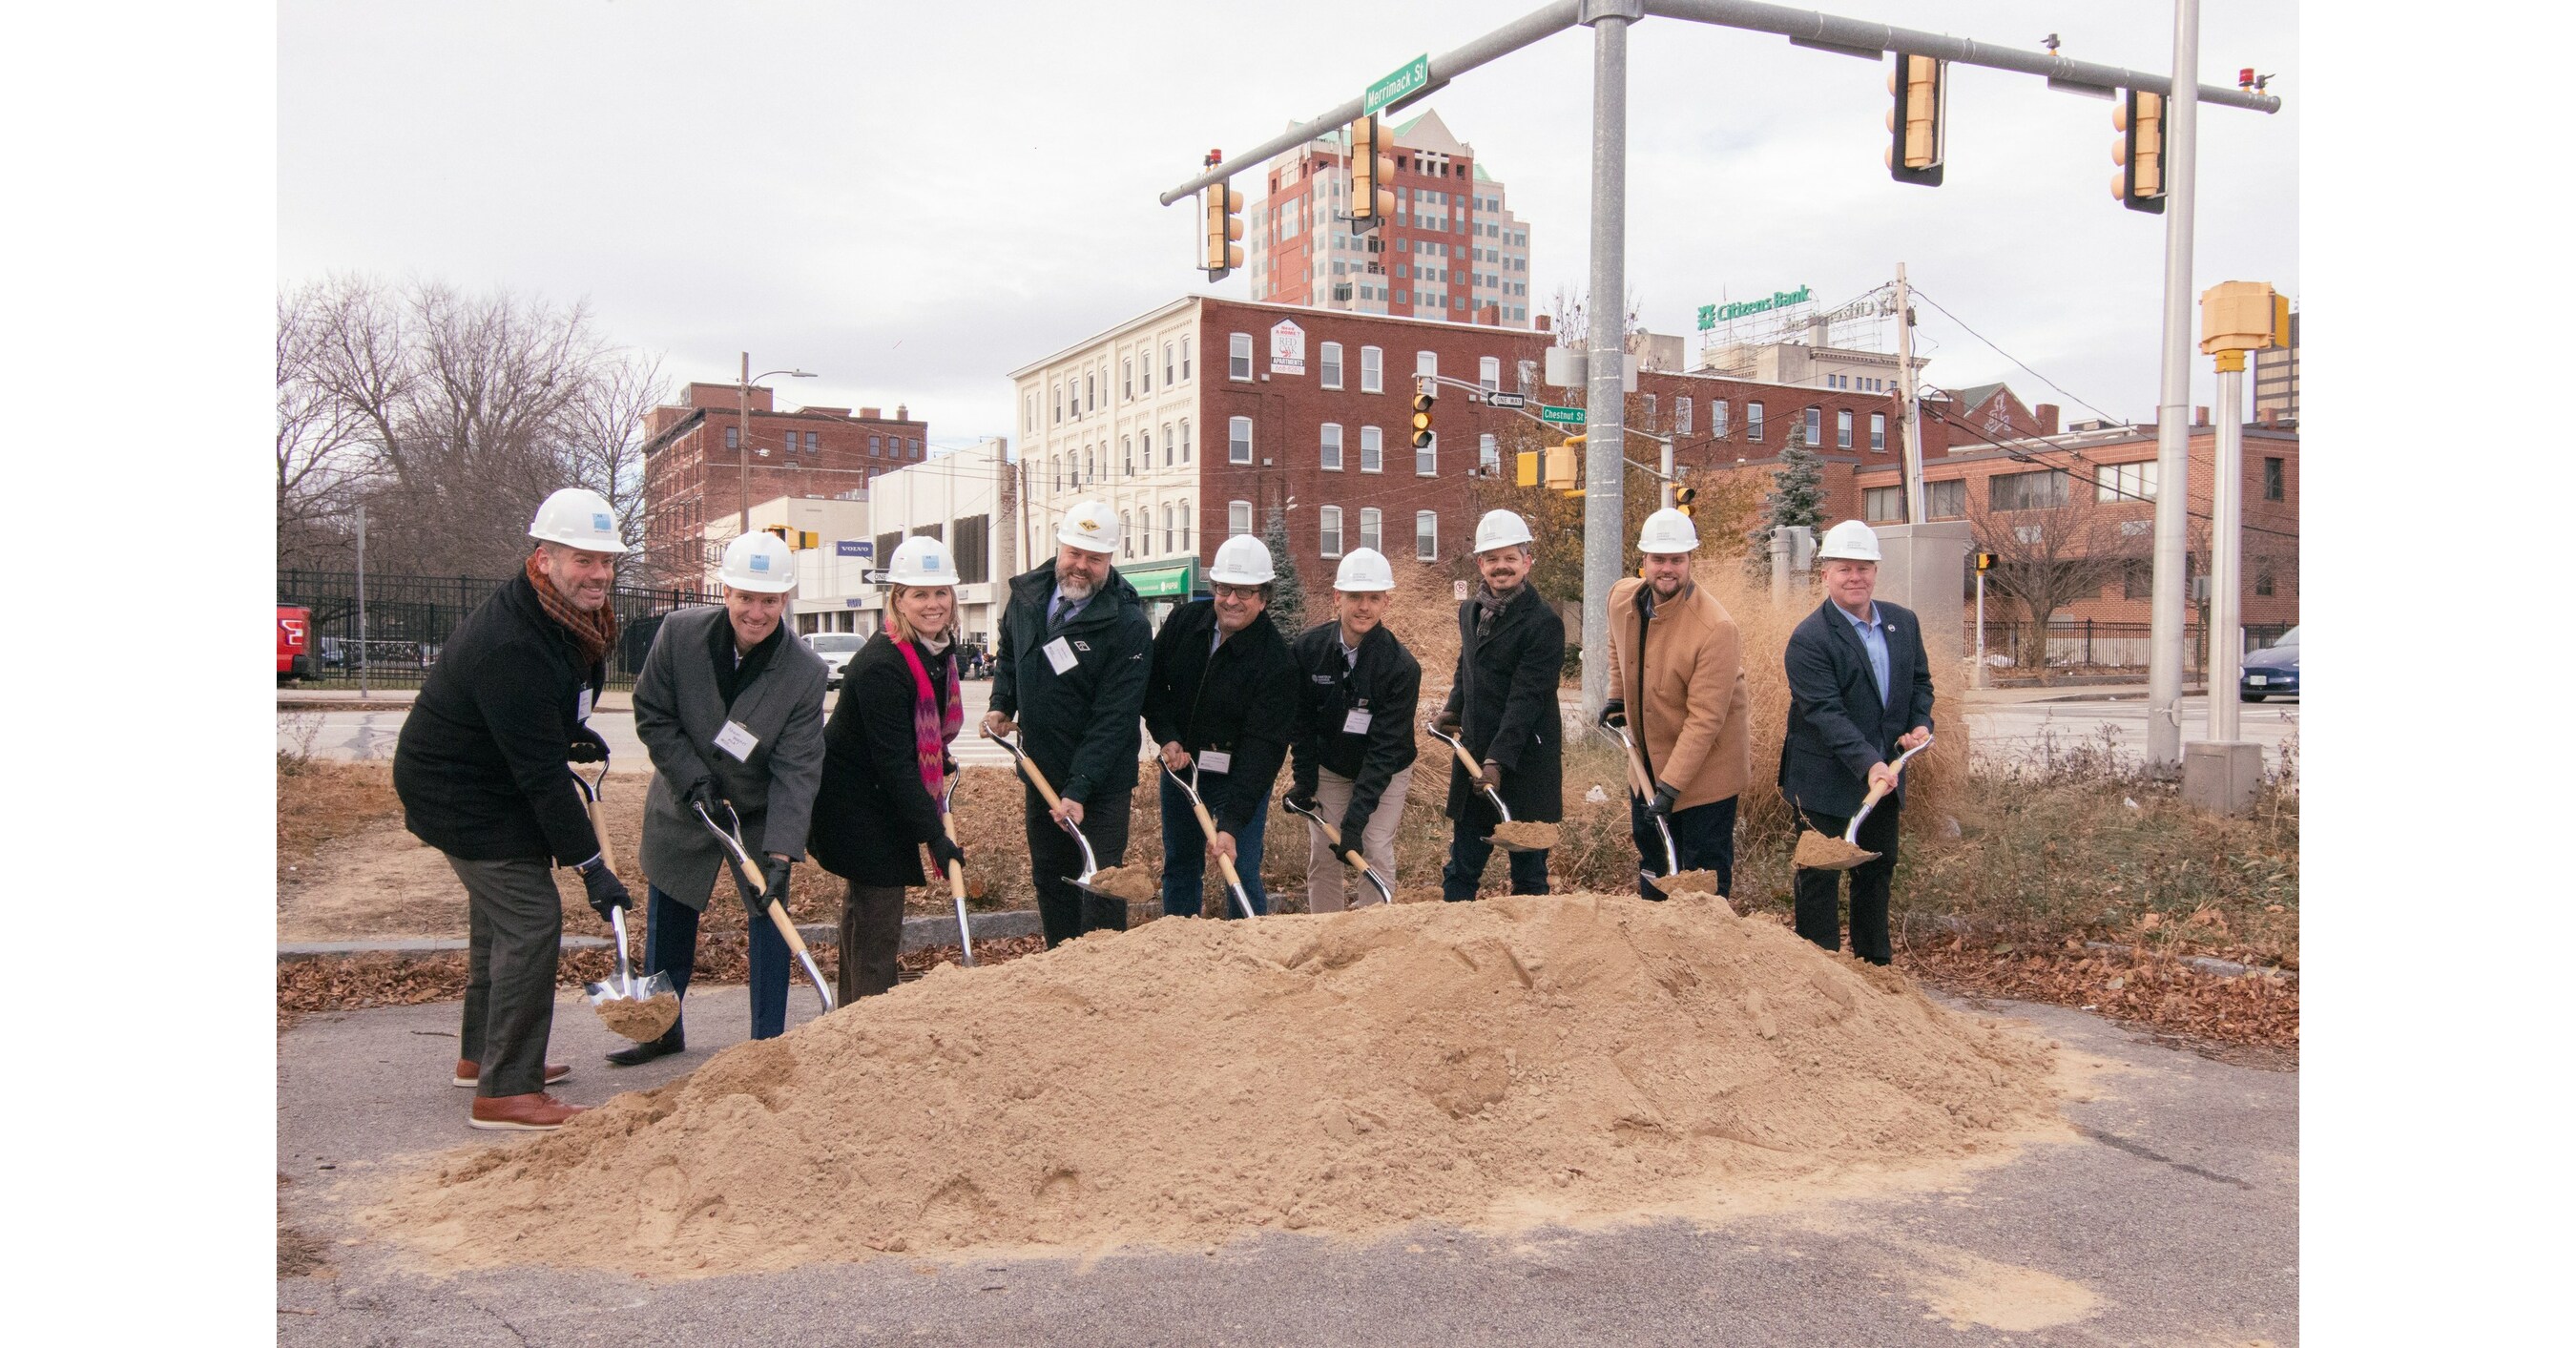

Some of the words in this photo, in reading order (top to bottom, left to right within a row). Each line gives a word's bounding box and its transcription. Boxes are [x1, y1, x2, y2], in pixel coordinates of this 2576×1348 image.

[1367, 70, 1411, 109] Merrimack
[1414, 62, 1424, 83] St
[1717, 298, 1773, 321] Citizens
[1774, 284, 1810, 308] Bank
[1279, 337, 1297, 346] RED
[1545, 409, 1574, 420] Chestnut
[1576, 411, 1584, 421] St
